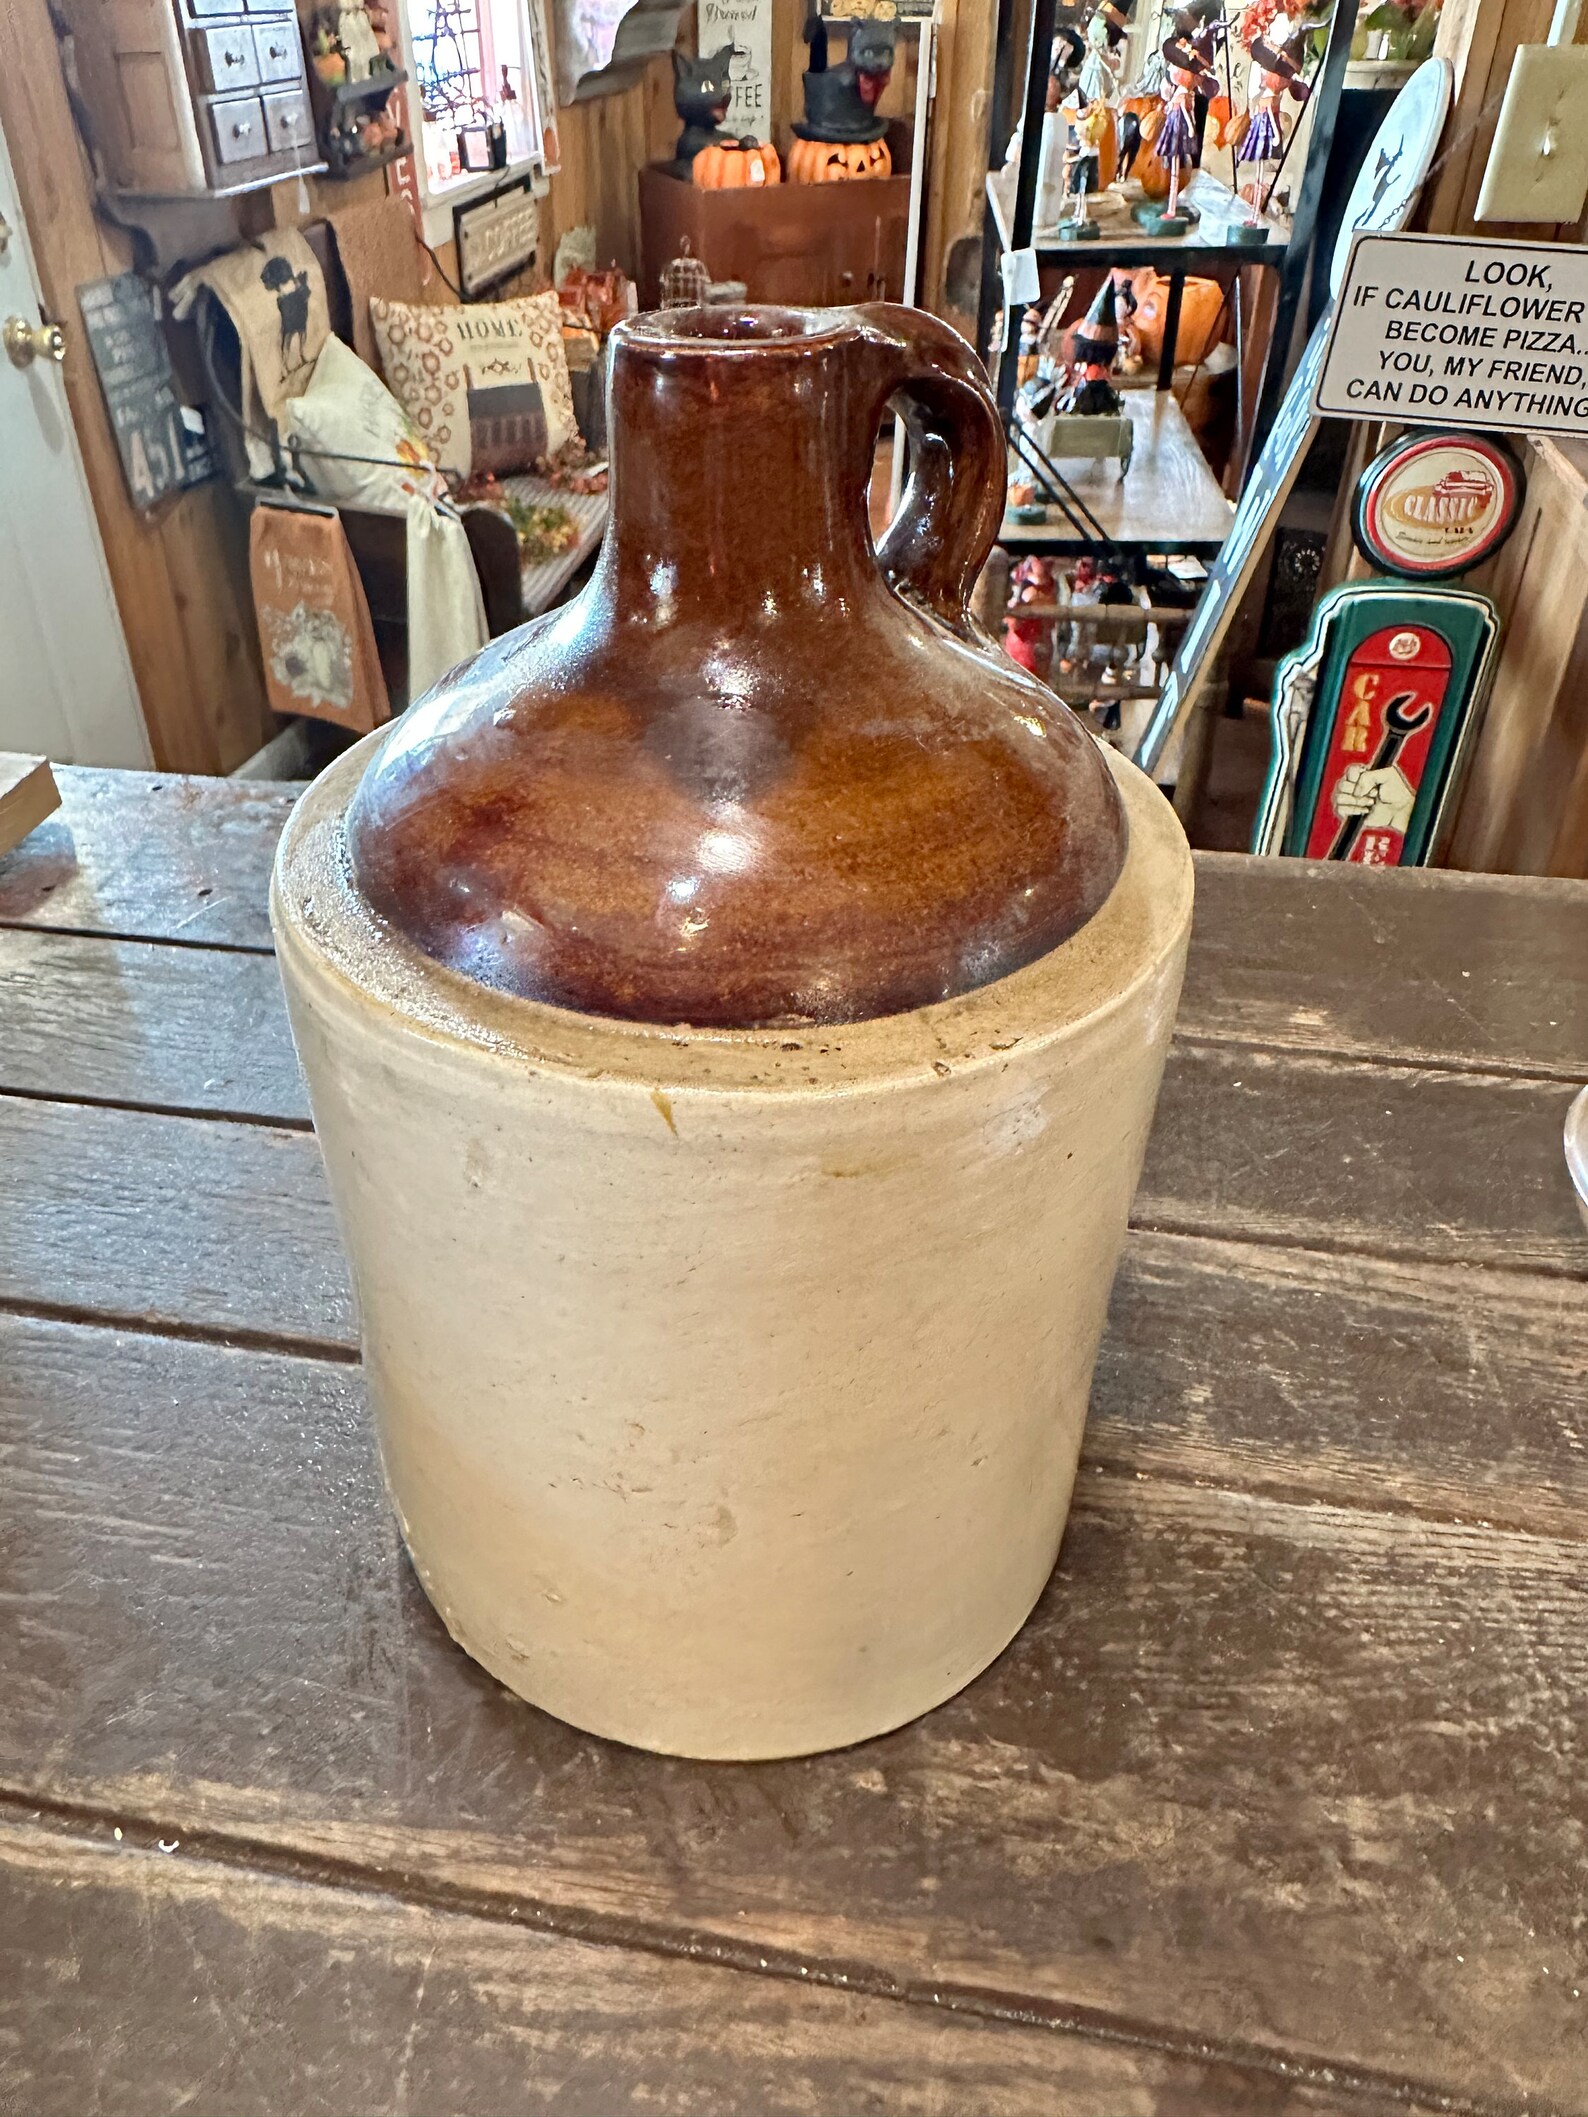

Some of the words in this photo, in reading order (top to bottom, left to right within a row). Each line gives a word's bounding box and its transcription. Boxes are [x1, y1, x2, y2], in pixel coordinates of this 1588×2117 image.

[1465, 260, 1553, 293] LOOK,
[1353, 286, 1379, 307] IF
[1385, 288, 1586, 324] CAULIFLOWER
[456, 318, 523, 340] HOME
[1384, 320, 1498, 348] BECOME
[1379, 350, 1434, 377] YOU,
[1443, 356, 1484, 377] MY
[1487, 359, 1586, 390] FRIEND,
[1346, 378, 1403, 401] CAN
[1408, 383, 1449, 406] DO
[1453, 388, 1588, 418] ANYTHING
[1403, 494, 1479, 525] CLASSIC
